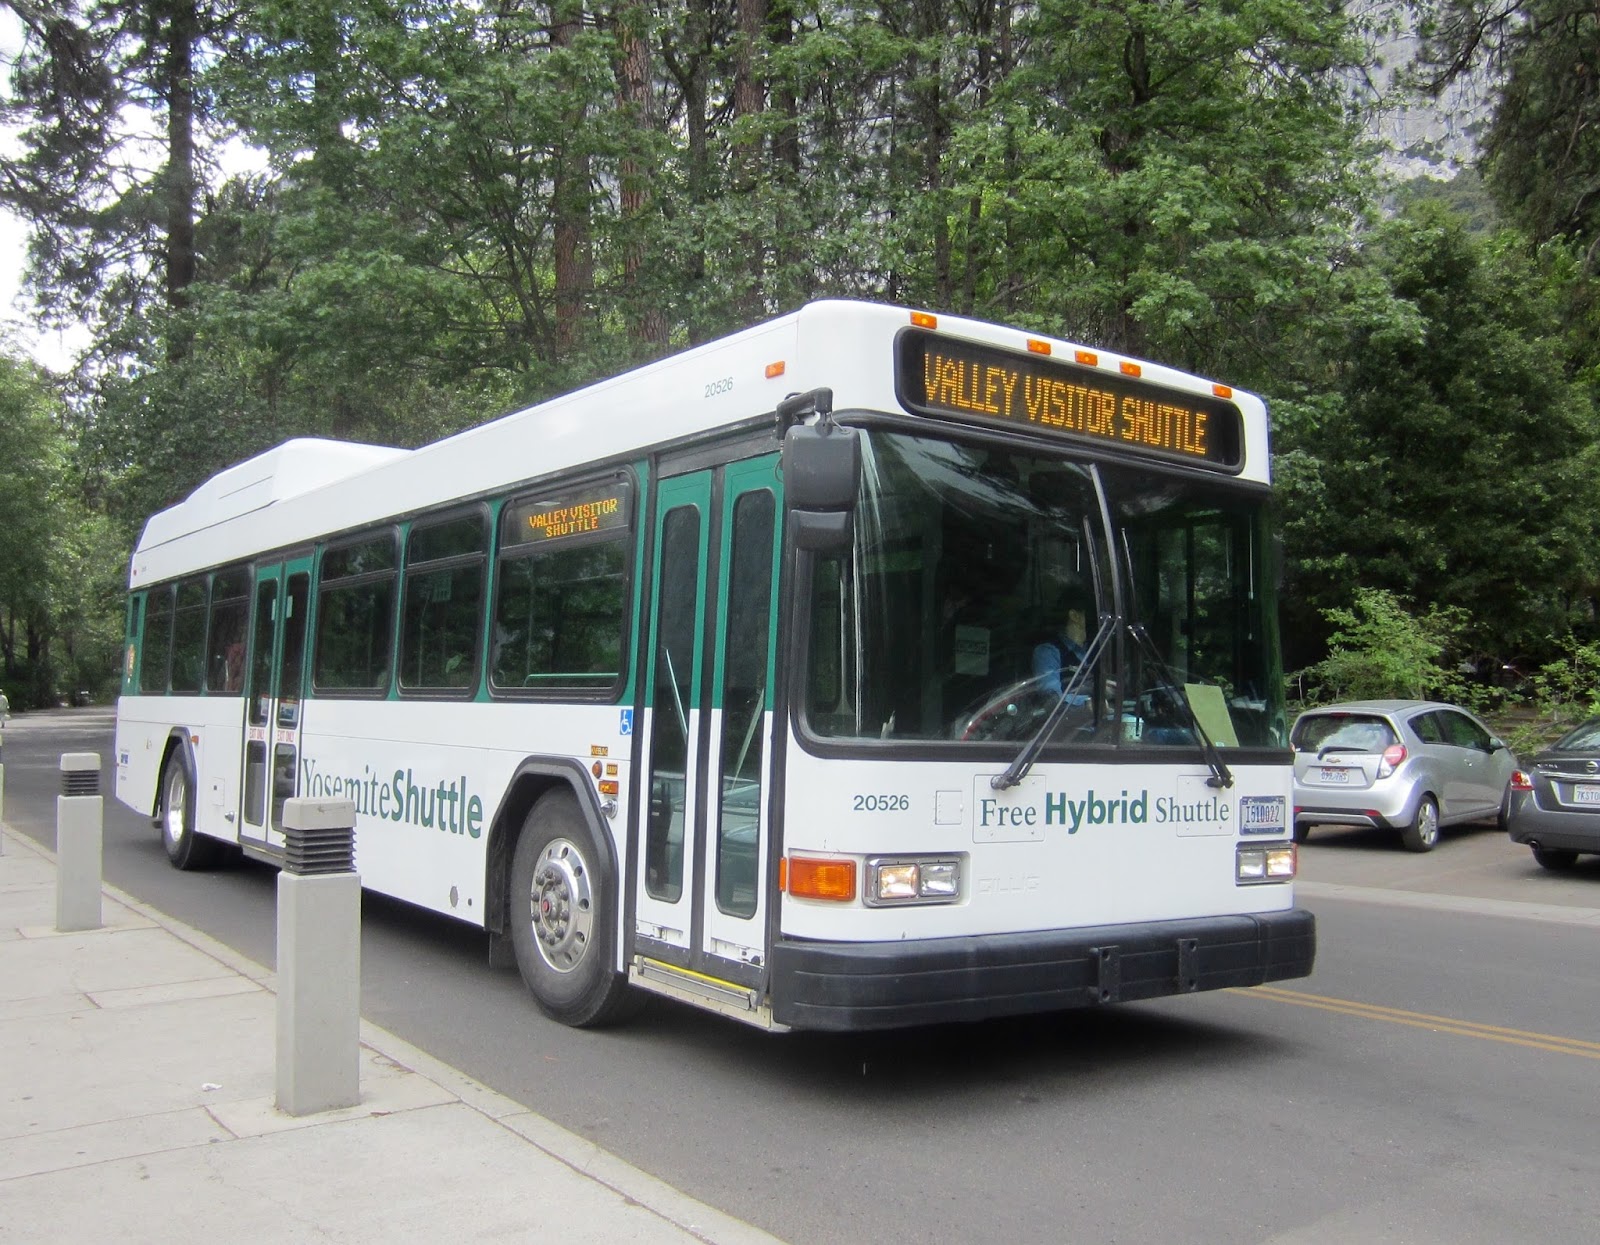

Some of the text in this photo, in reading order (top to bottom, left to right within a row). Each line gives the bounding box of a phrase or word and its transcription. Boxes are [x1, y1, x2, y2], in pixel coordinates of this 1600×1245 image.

[705, 376, 734, 399] 20526
[924, 352, 1207, 455] VALLEY VISITOR SHUTTLE
[528, 498, 618, 529] VALLEY VISITOR
[545, 516, 599, 538] SHUTTLE
[853, 794, 910, 811] 20526
[979, 789, 1230, 835] Free Hybrid Shuttle
